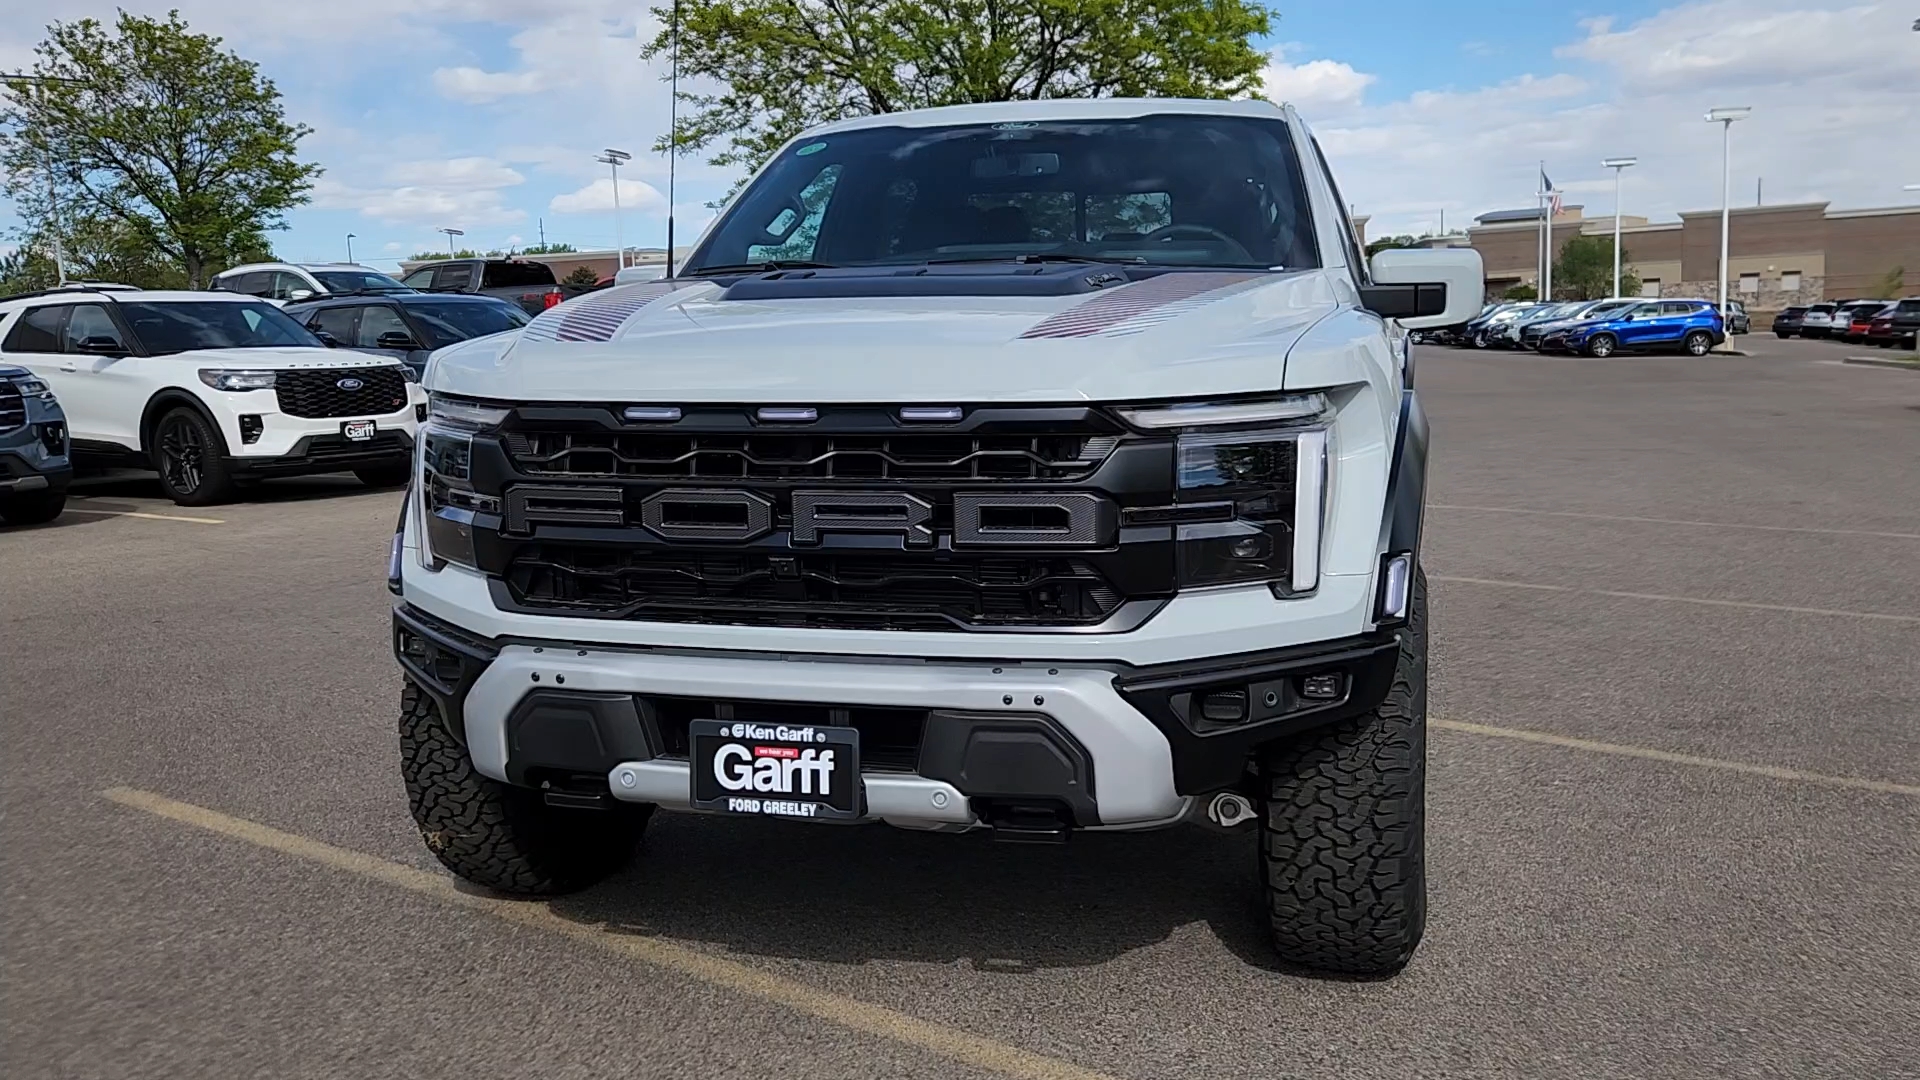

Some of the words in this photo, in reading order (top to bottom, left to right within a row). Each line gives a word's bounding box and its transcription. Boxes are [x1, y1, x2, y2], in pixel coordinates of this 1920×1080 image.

[344, 423, 375, 438] Garff
[505, 484, 1108, 547] FORD
[745, 724, 775, 740] Ken
[776, 726, 814, 742] Garff
[714, 743, 834, 795] Garff
[729, 798, 760, 812] FORD
[763, 800, 817, 816] GREELEY
